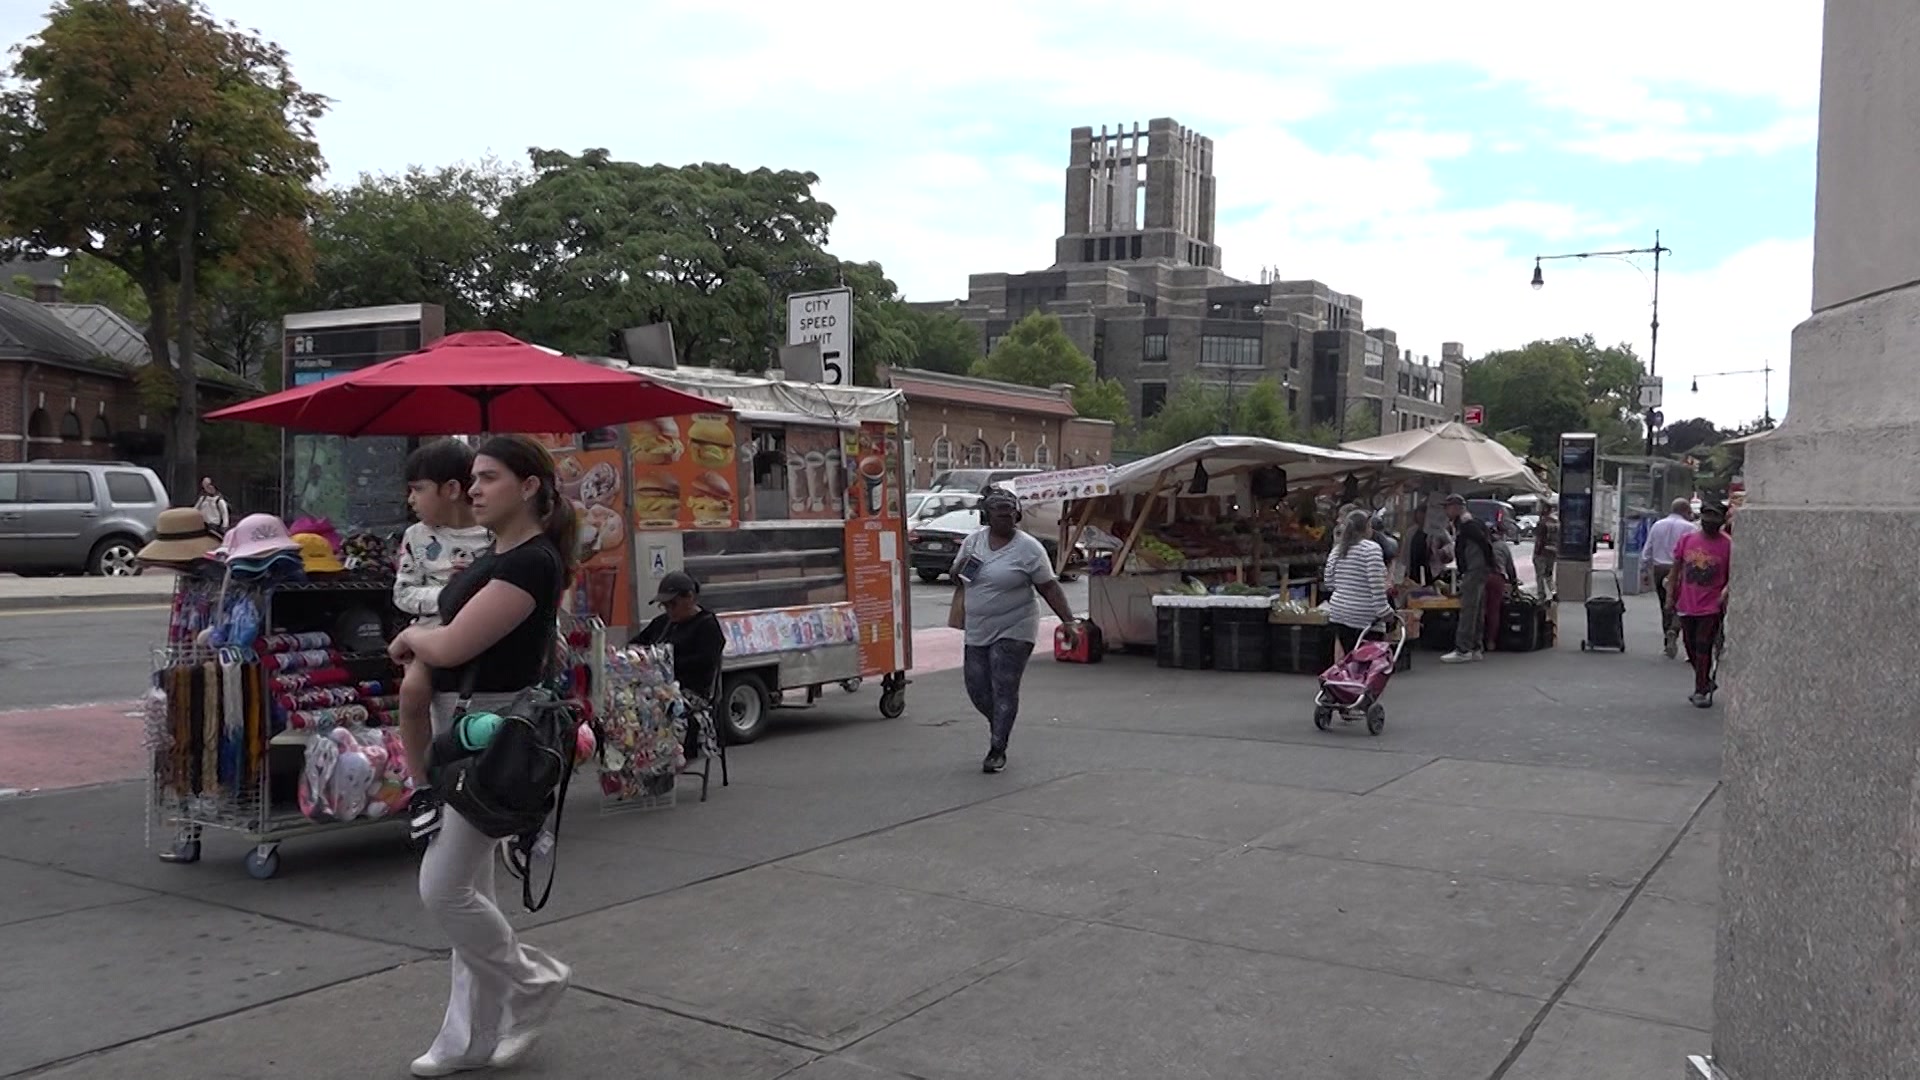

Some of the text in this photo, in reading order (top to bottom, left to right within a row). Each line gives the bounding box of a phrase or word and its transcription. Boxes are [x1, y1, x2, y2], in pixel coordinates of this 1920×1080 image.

[804, 299, 830, 313] CITY
[800, 315, 836, 330] SPEED
[654, 553, 664, 568] A
